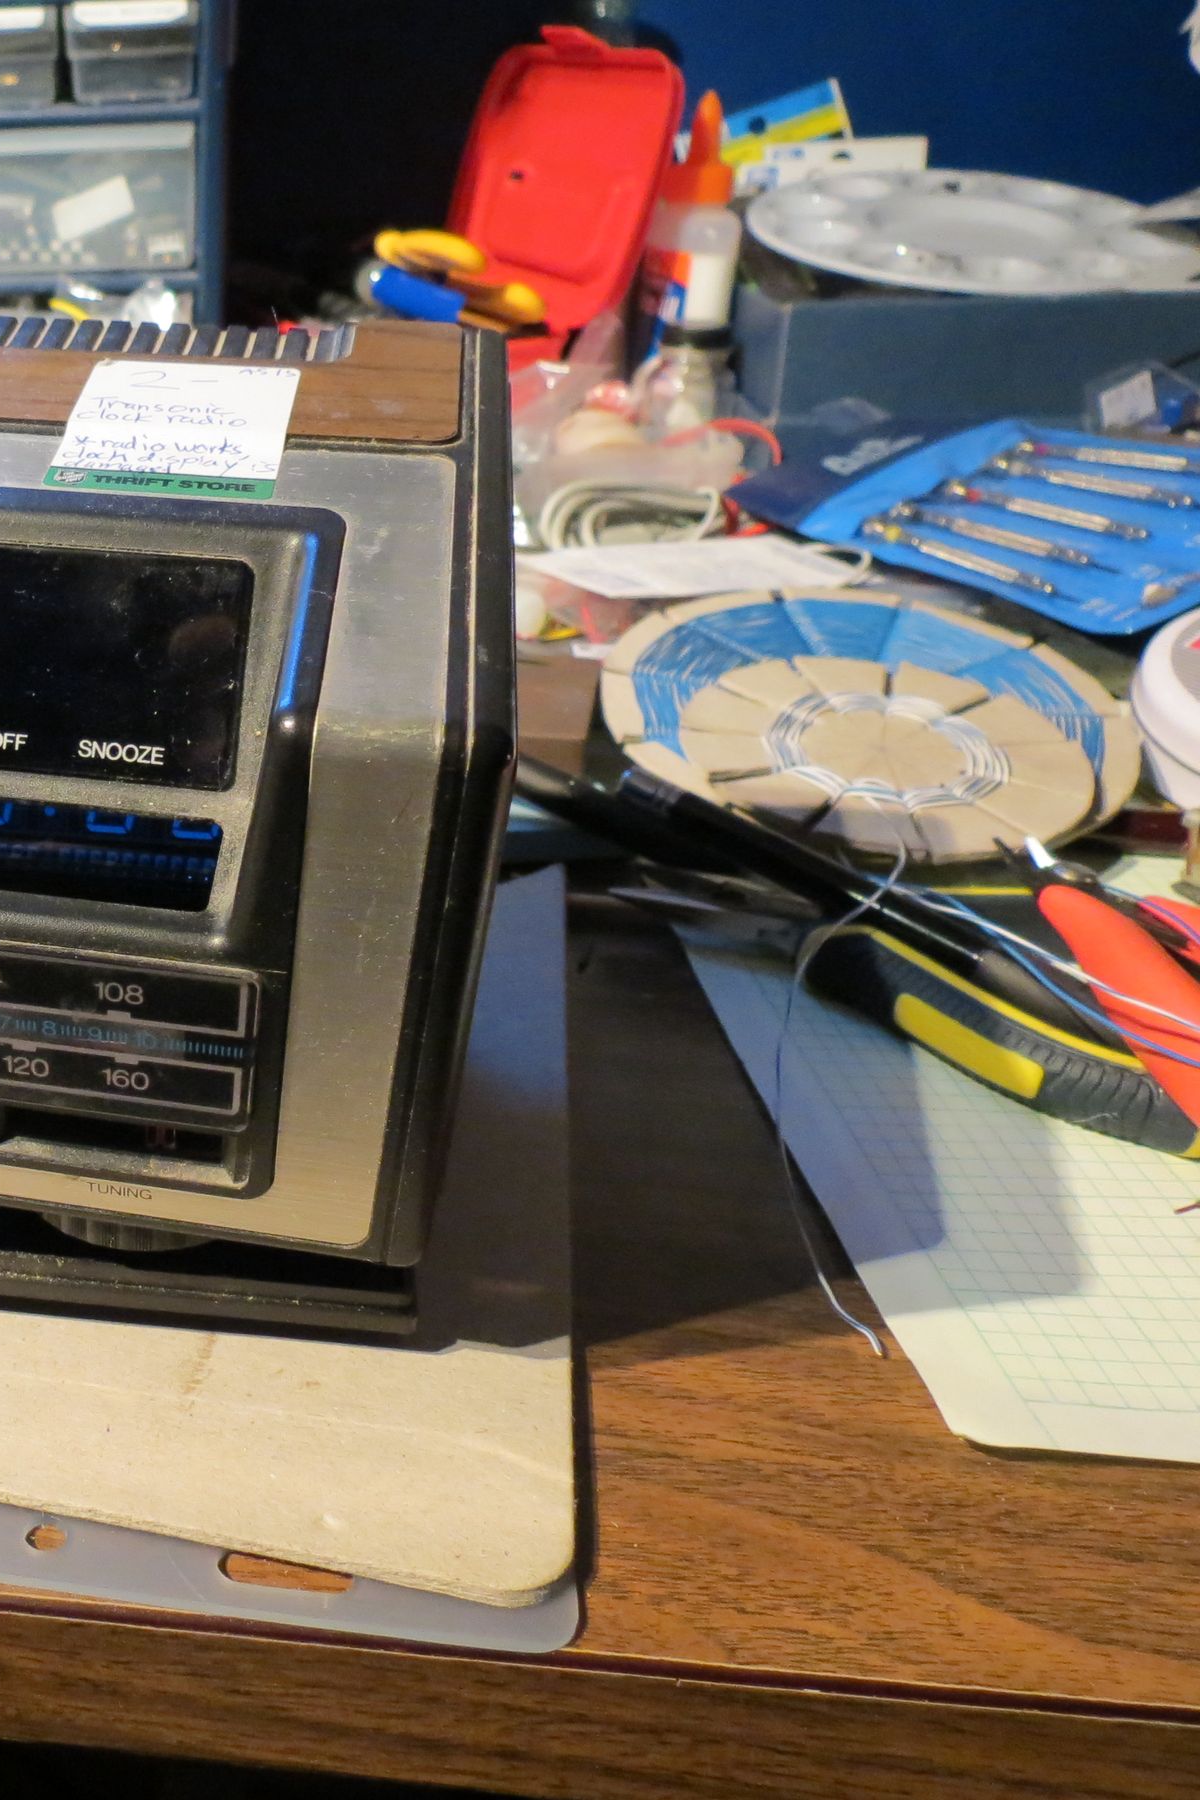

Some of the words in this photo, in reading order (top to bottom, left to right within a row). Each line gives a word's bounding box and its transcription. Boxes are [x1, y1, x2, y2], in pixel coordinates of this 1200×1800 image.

[92, 396, 236, 415] Transonic
[76, 409, 152, 423] clock
[167, 414, 247, 428] radio
[101, 434, 166, 453] radio
[93, 474, 176, 488] THRIFT
[178, 480, 257, 493] STORE
[78, 739, 165, 766] SNOOZE
[95, 982, 144, 1005] 108
[41, 1020, 57, 1037] 8
[87, 1026, 102, 1042] 9
[2, 1055, 50, 1078] 120
[102, 1068, 150, 1091] 160
[87, 1180, 153, 1201] TUNING
